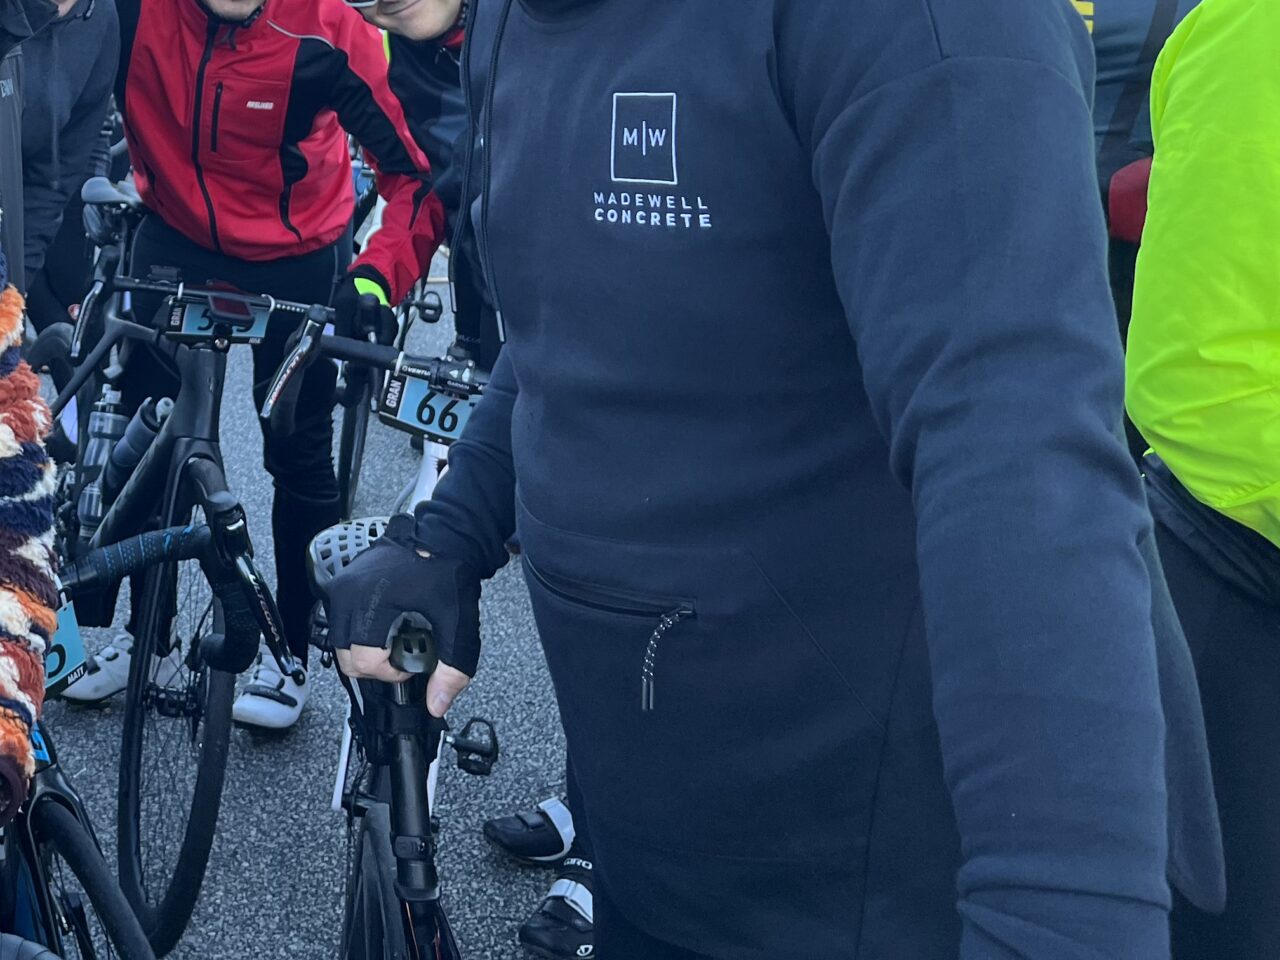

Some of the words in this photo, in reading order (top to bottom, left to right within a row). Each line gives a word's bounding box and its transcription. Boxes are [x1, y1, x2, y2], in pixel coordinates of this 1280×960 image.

[593, 192, 709, 210] MADEWELL
[594, 208, 712, 228] CONCRETE
[408, 366, 431, 376] VENTU
[385, 380, 402, 408] GRAN
[416, 390, 476, 433] 66
[67, 666, 84, 685] MATT
